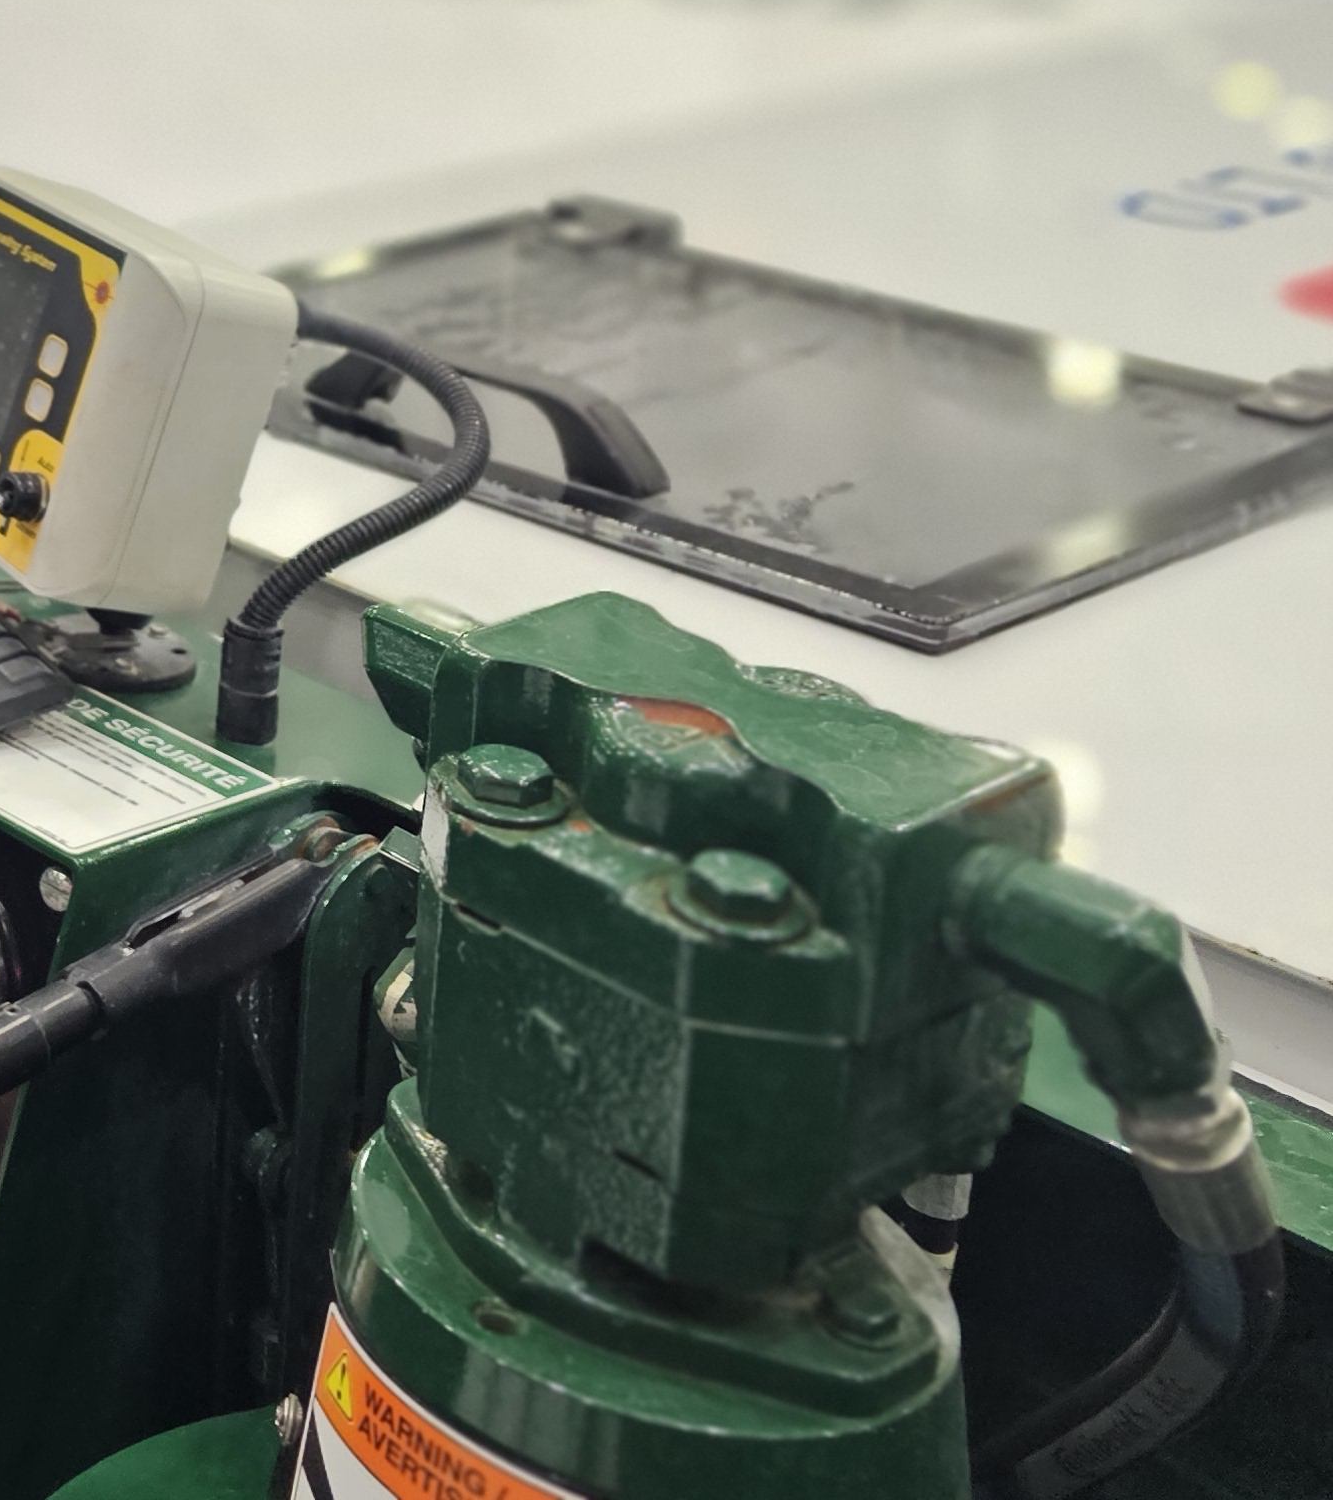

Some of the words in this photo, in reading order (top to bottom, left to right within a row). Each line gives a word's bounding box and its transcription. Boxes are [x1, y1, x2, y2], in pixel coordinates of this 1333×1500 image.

[20, 245, 57, 272] System
[66, 699, 109, 722] DE
[104, 718, 248, 790] SÉCURITÉ
[364, 1381, 487, 1497] WARNING
